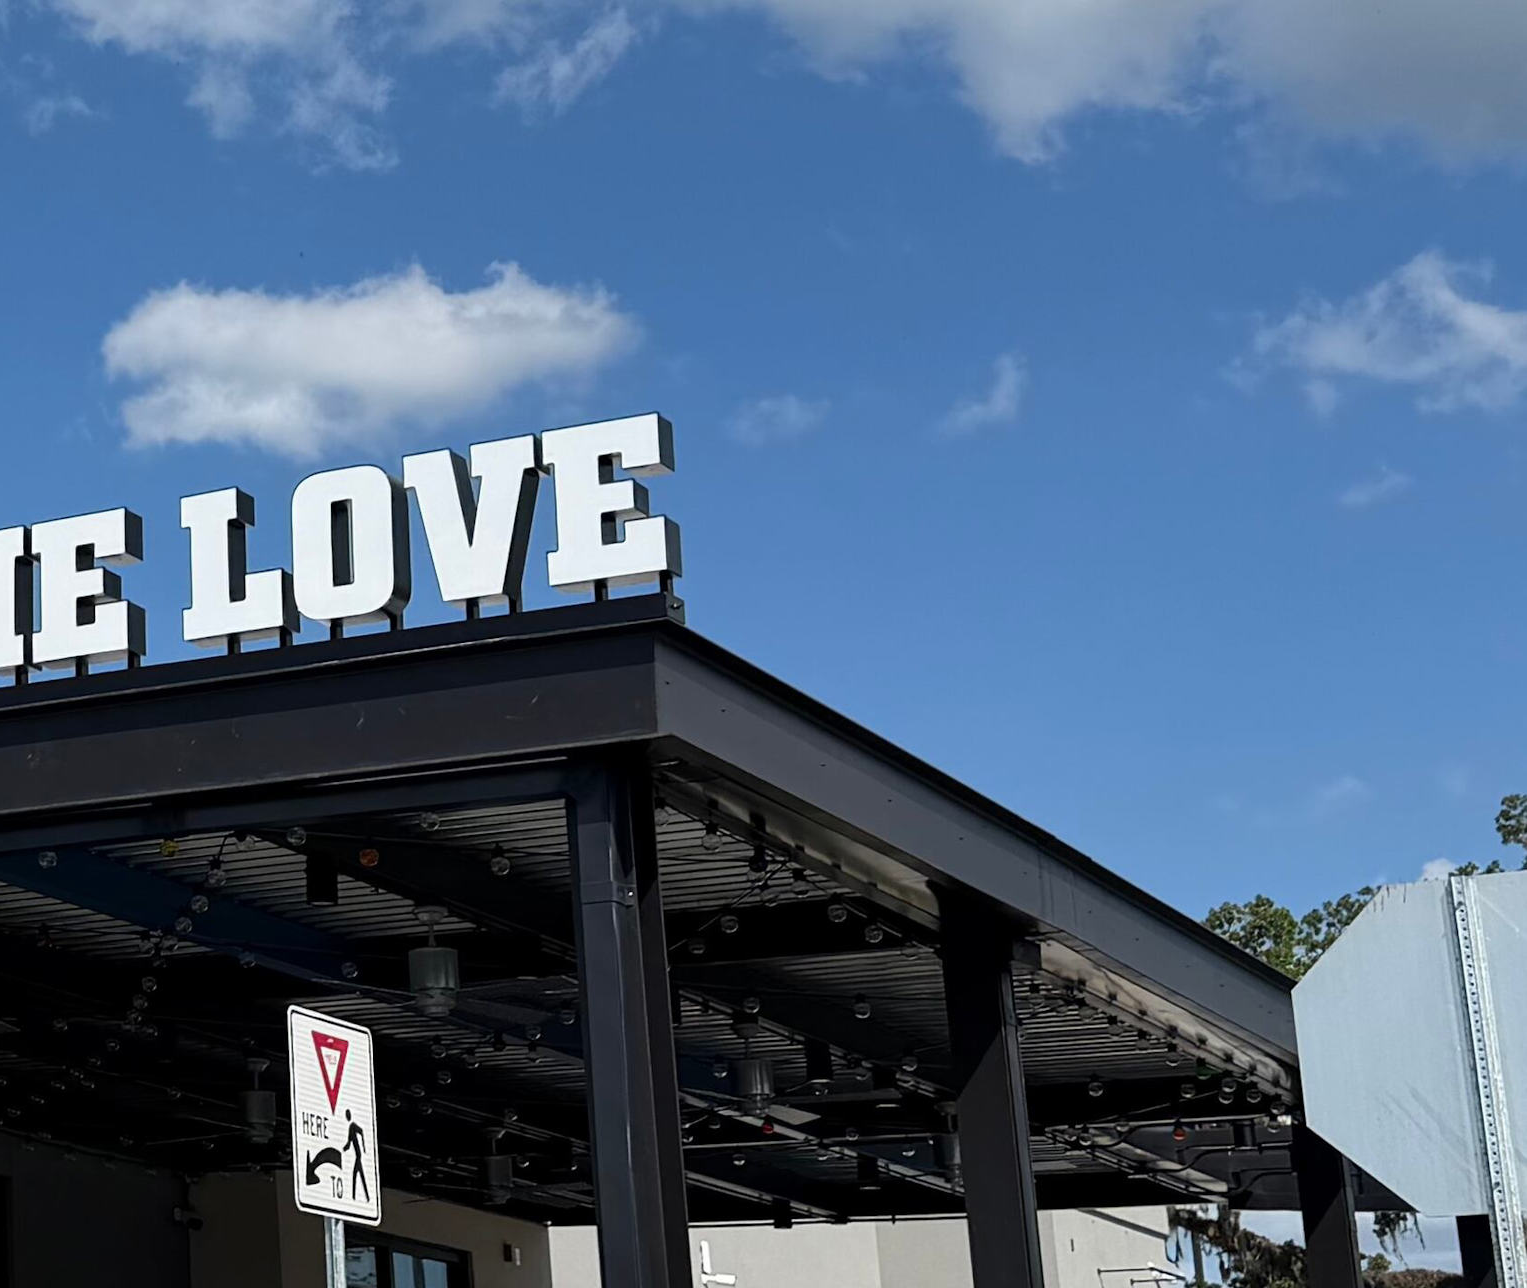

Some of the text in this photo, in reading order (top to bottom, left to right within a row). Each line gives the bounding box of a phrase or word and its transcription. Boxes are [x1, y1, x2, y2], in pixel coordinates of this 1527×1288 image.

[180, 411, 681, 647] LOVE
[302, 1111, 329, 1140] HERE
[330, 1175, 343, 1199] TO
